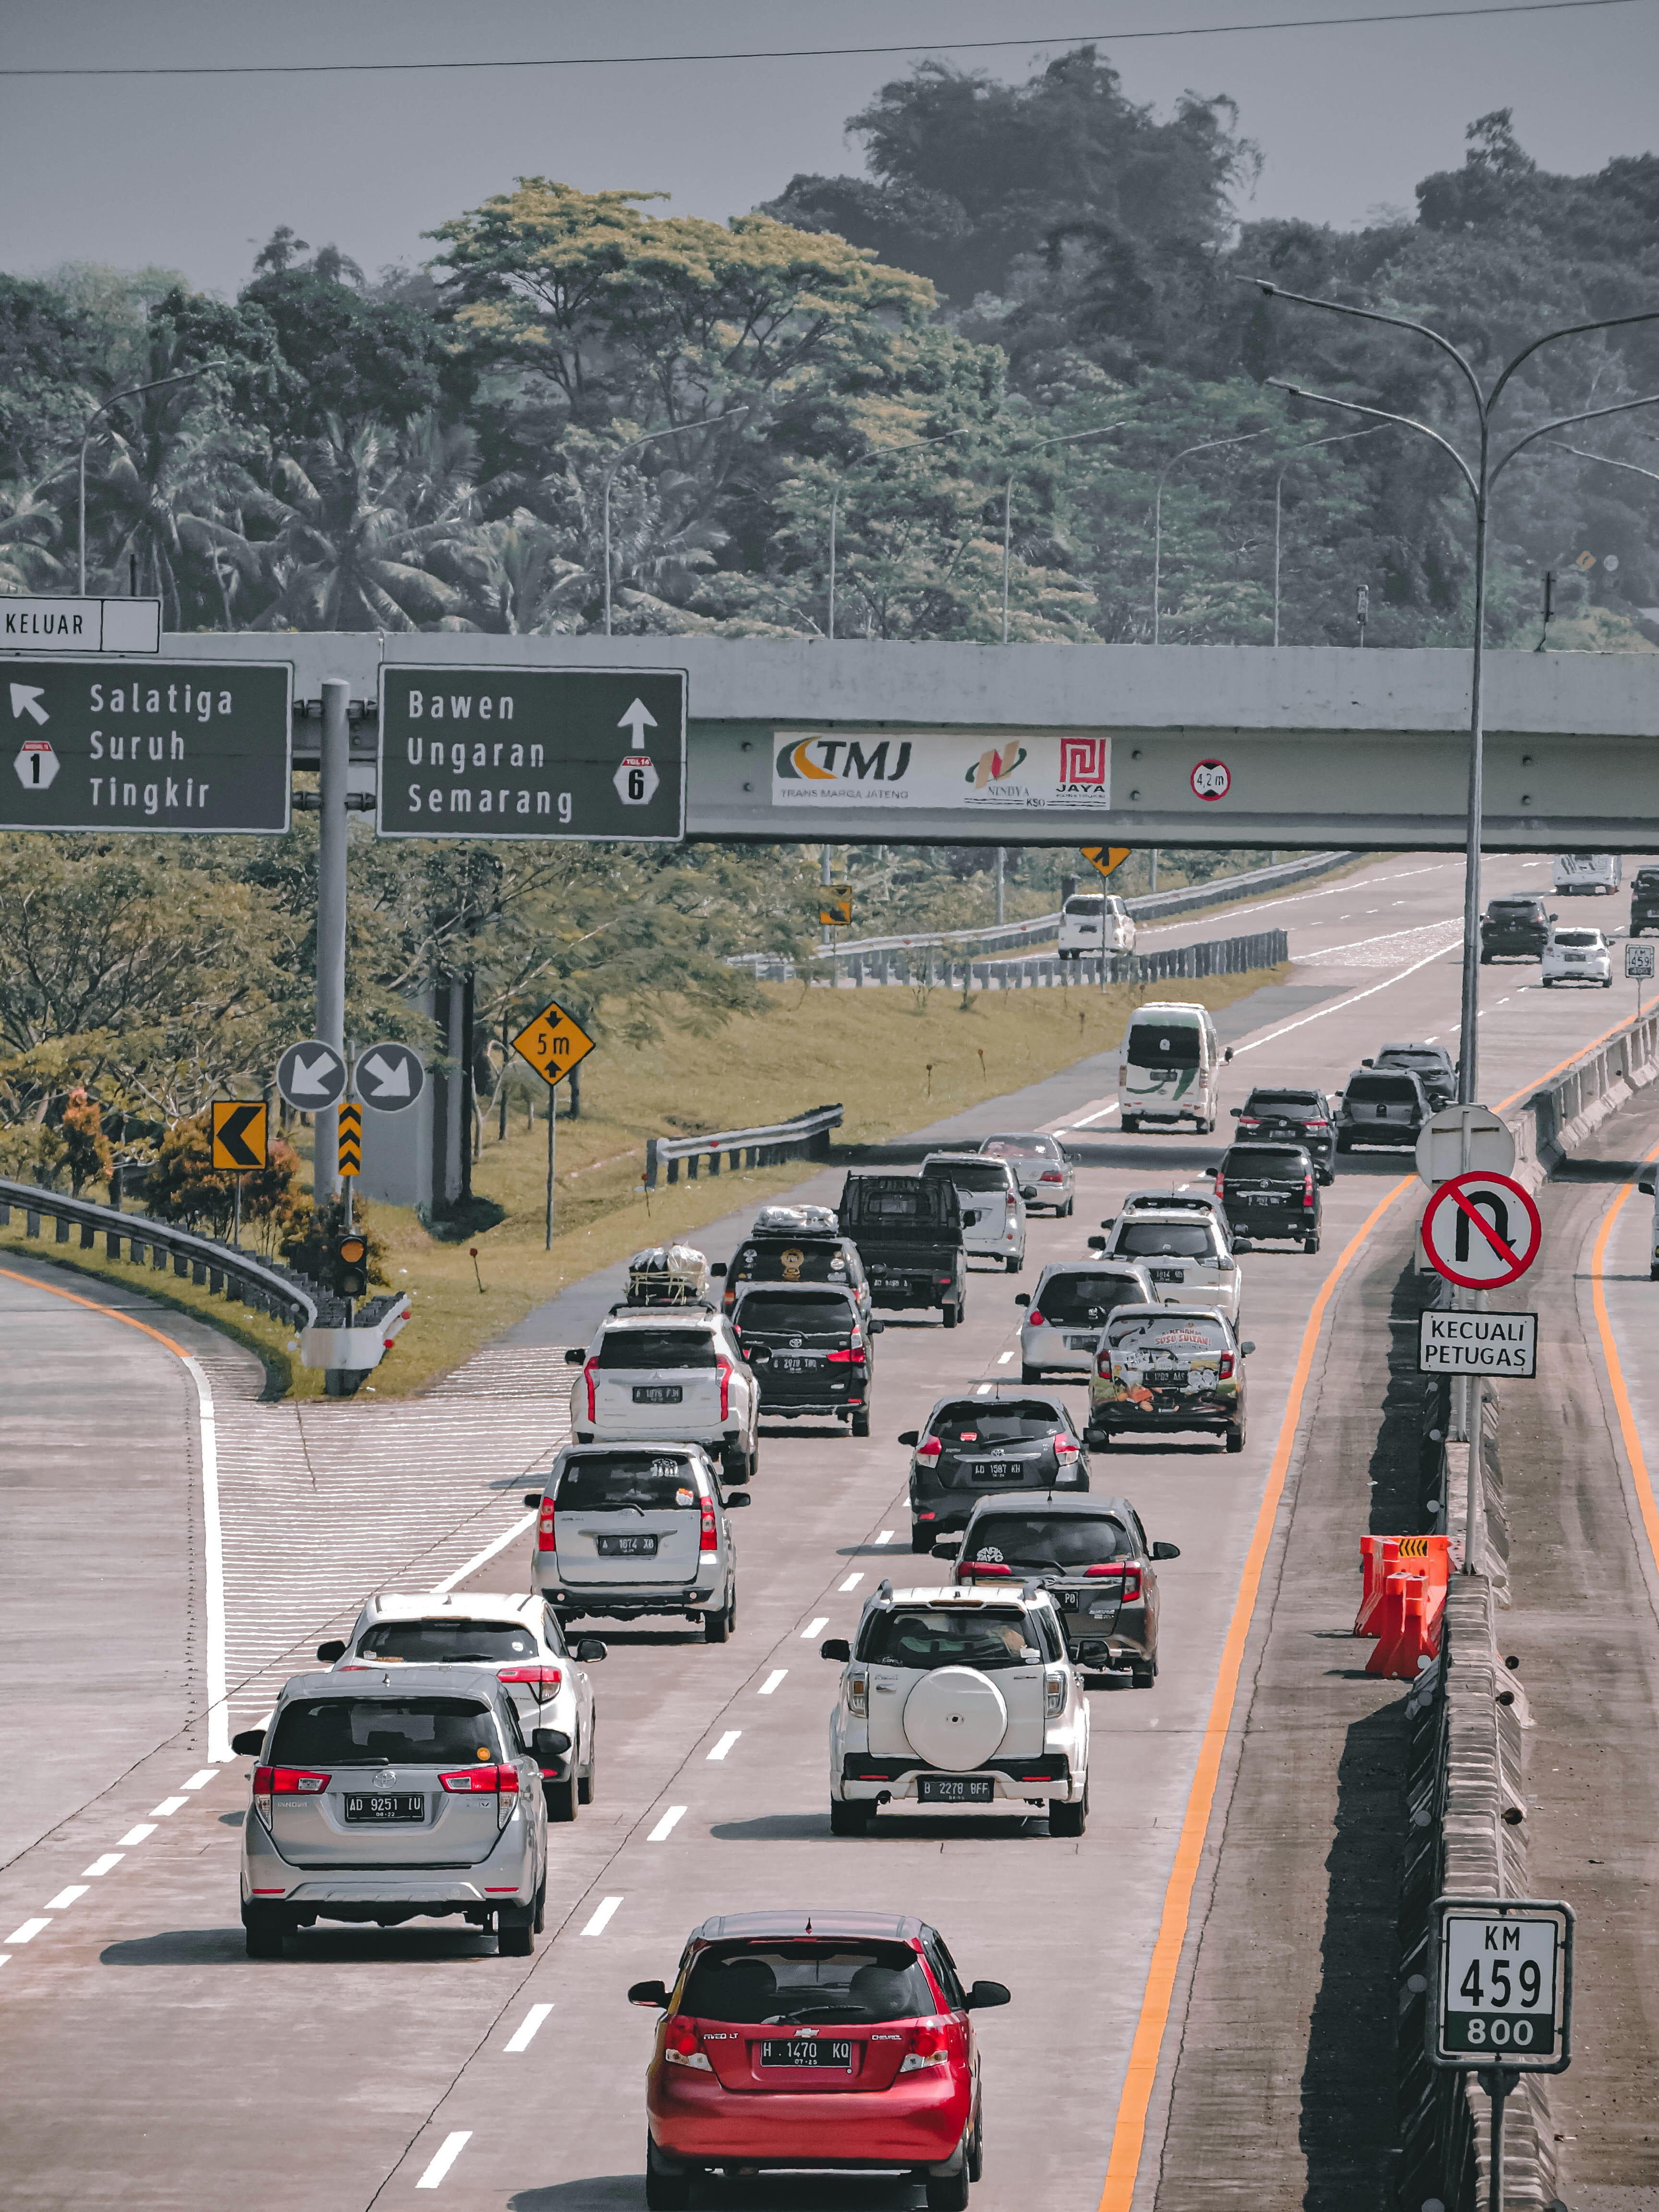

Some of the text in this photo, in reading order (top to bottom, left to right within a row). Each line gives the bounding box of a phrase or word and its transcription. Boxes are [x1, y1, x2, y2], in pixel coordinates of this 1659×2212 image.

[6, 613, 83, 635] KELUAR
[90, 683, 232, 722] Salatiga
[409, 690, 514, 720] Bawen
[90, 730, 184, 760] Suruh
[408, 737, 544, 775] Ungaran
[30, 753, 40, 783] 1
[817, 741, 912, 781] TMJ
[90, 778, 209, 815] Tingkir
[628, 769, 644, 800] 6
[781, 789, 818, 798] TRANS
[988, 785, 1030, 797] NINDYA
[1056, 784, 1106, 793] JAYA
[409, 784, 572, 824] Semarang
[1026, 797, 1046, 807] KSO
[1631, 956, 1649, 967] 459
[537, 1033, 570, 1055] 5 m
[1431, 1320, 1525, 1342] KECUALI
[1424, 1345, 1527, 1367] PETUGAS
[924, 1782, 930, 1794] B
[970, 1782, 988, 1794] BFF
[349, 1799, 363, 1812] AD
[371, 1798, 397, 1812] 9251
[1485, 1925, 1520, 1951] KM
[1460, 1959, 1541, 2008] 459
[1467, 2019, 1534, 2046] 800
[763, 2042, 849, 2058] H 1470 KQ
